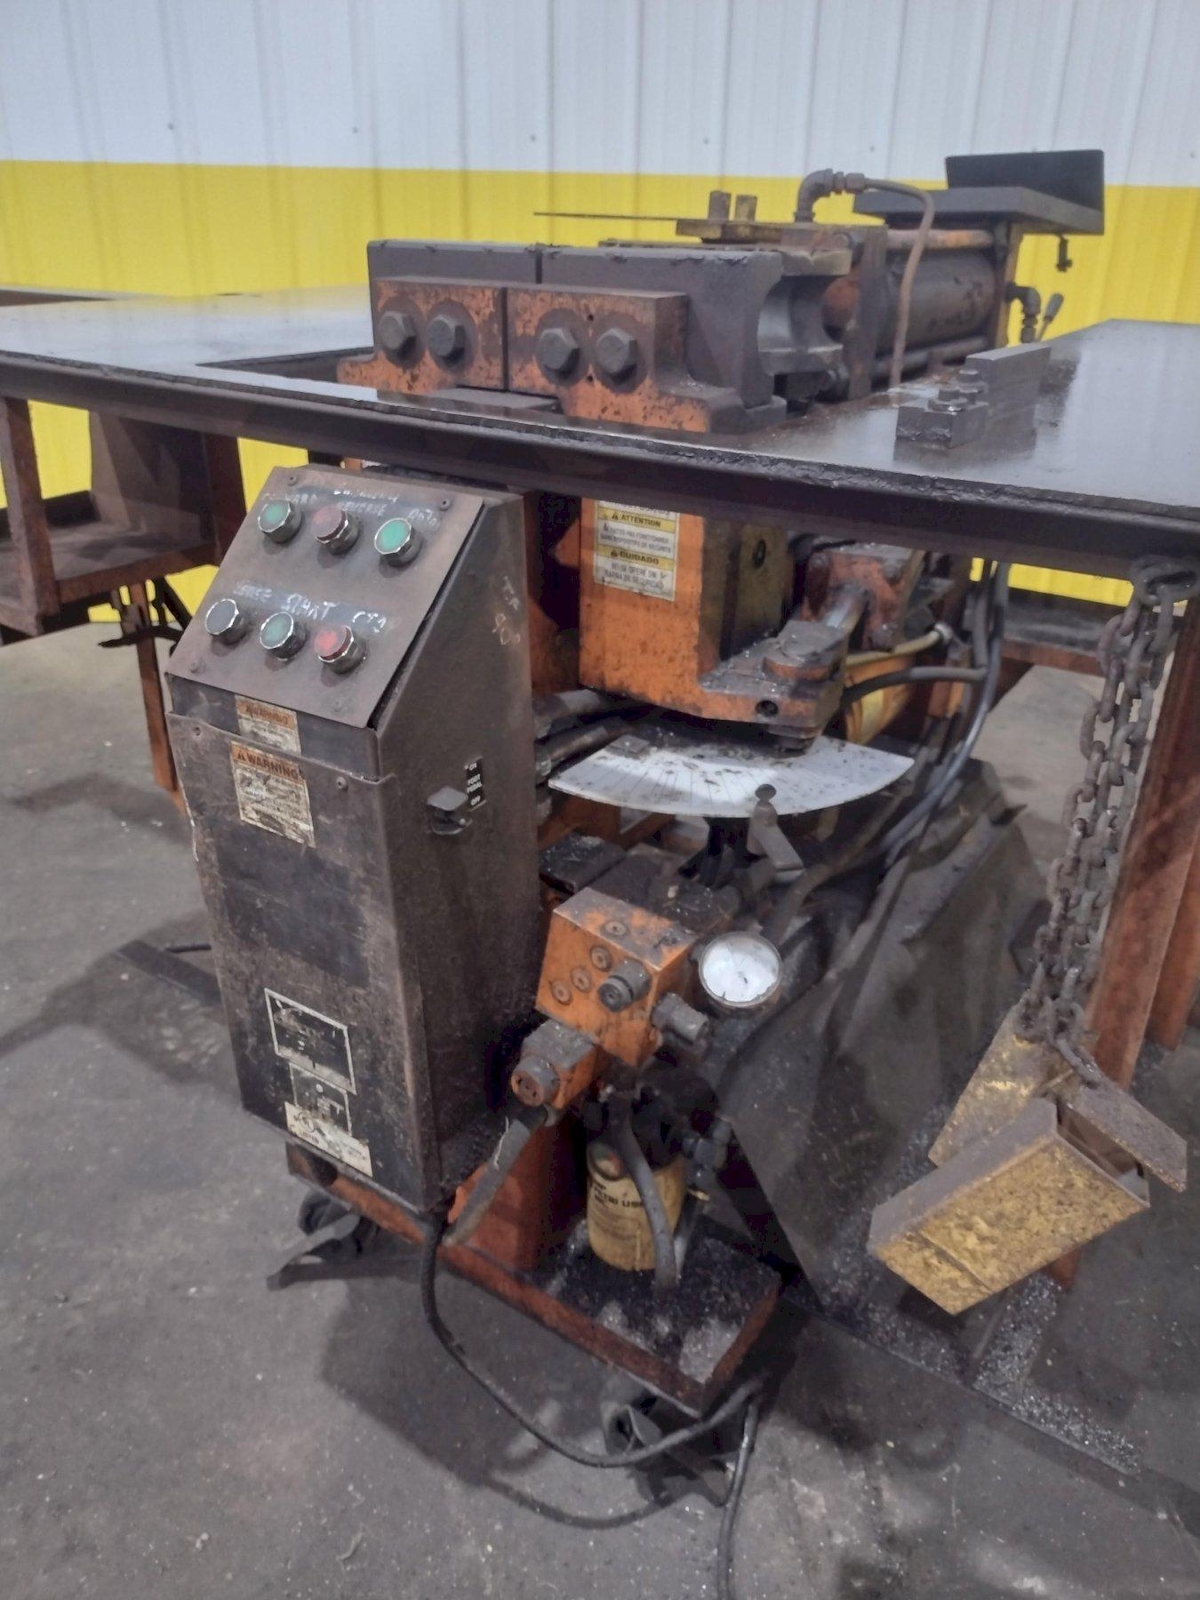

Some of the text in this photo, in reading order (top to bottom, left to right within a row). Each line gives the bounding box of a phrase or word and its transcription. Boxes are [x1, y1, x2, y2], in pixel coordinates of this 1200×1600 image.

[621, 514, 661, 528] ATTENTION
[619, 550, 660, 565] CUIDADO
[281, 593, 336, 620] START
[246, 753, 299, 779] WARNING
